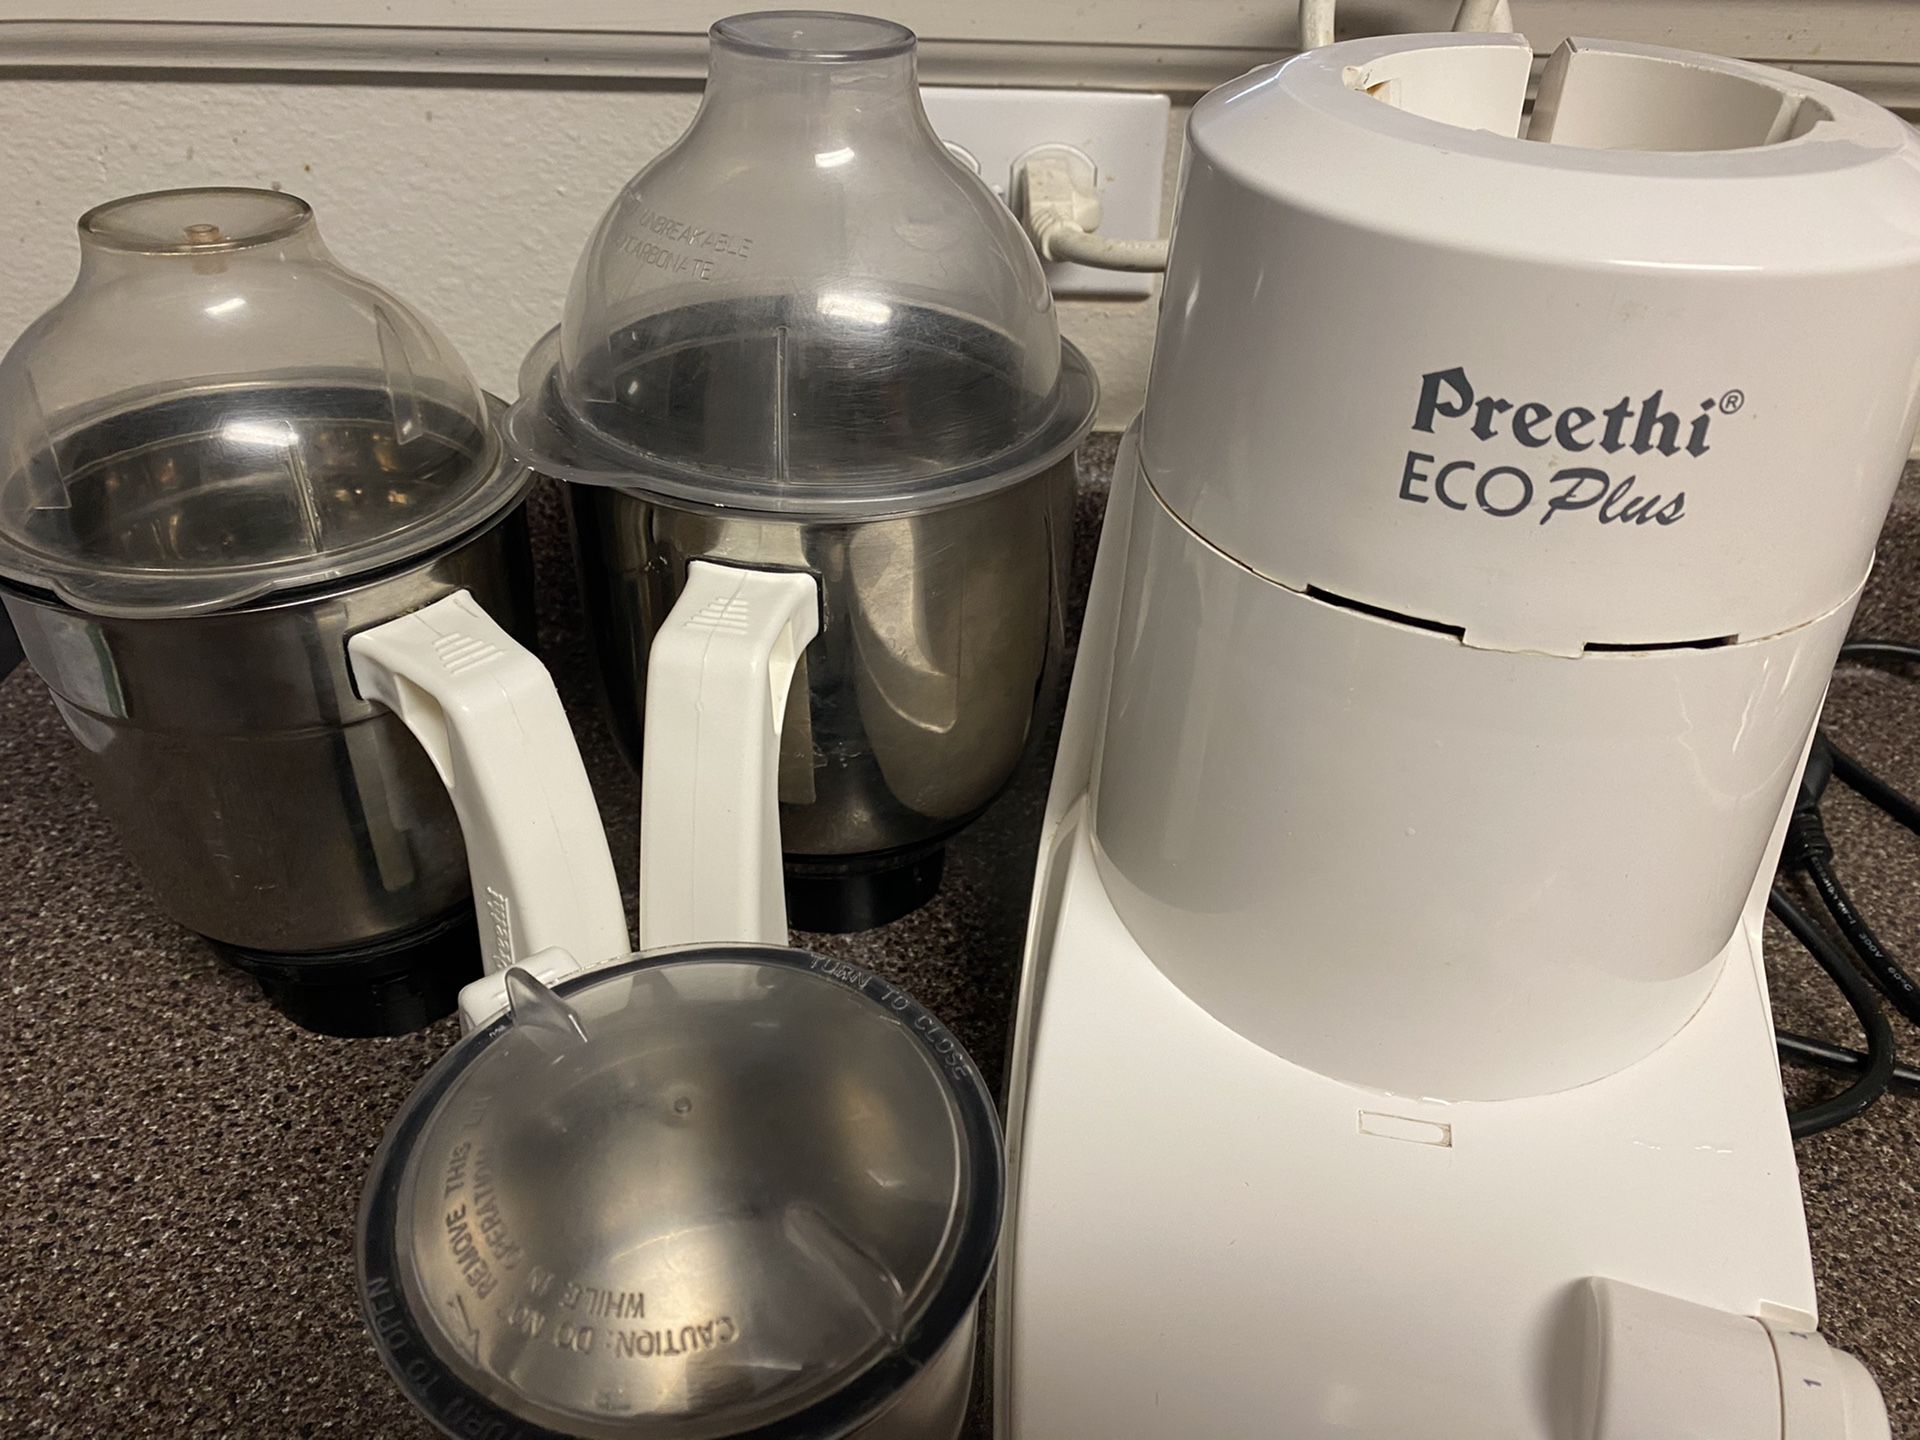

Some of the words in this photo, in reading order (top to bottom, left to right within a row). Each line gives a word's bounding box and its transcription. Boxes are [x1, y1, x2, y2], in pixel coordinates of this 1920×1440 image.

[619, 233, 715, 281] CARBONATE
[1399, 450, 1535, 518] ECO
[1539, 467, 1686, 526] Plus
[810, 952, 872, 990] TURN
[881, 984, 909, 1010] TO
[914, 1014, 968, 1081] CLOSE
[443, 1140, 472, 1201] THIS
[445, 1203, 499, 1300] REMOVE
[366, 1275, 411, 1350] OPEN
[558, 1281, 646, 1320] WHILE
[553, 1319, 595, 1355] DO
[1802, 1377, 1823, 1387] 1
